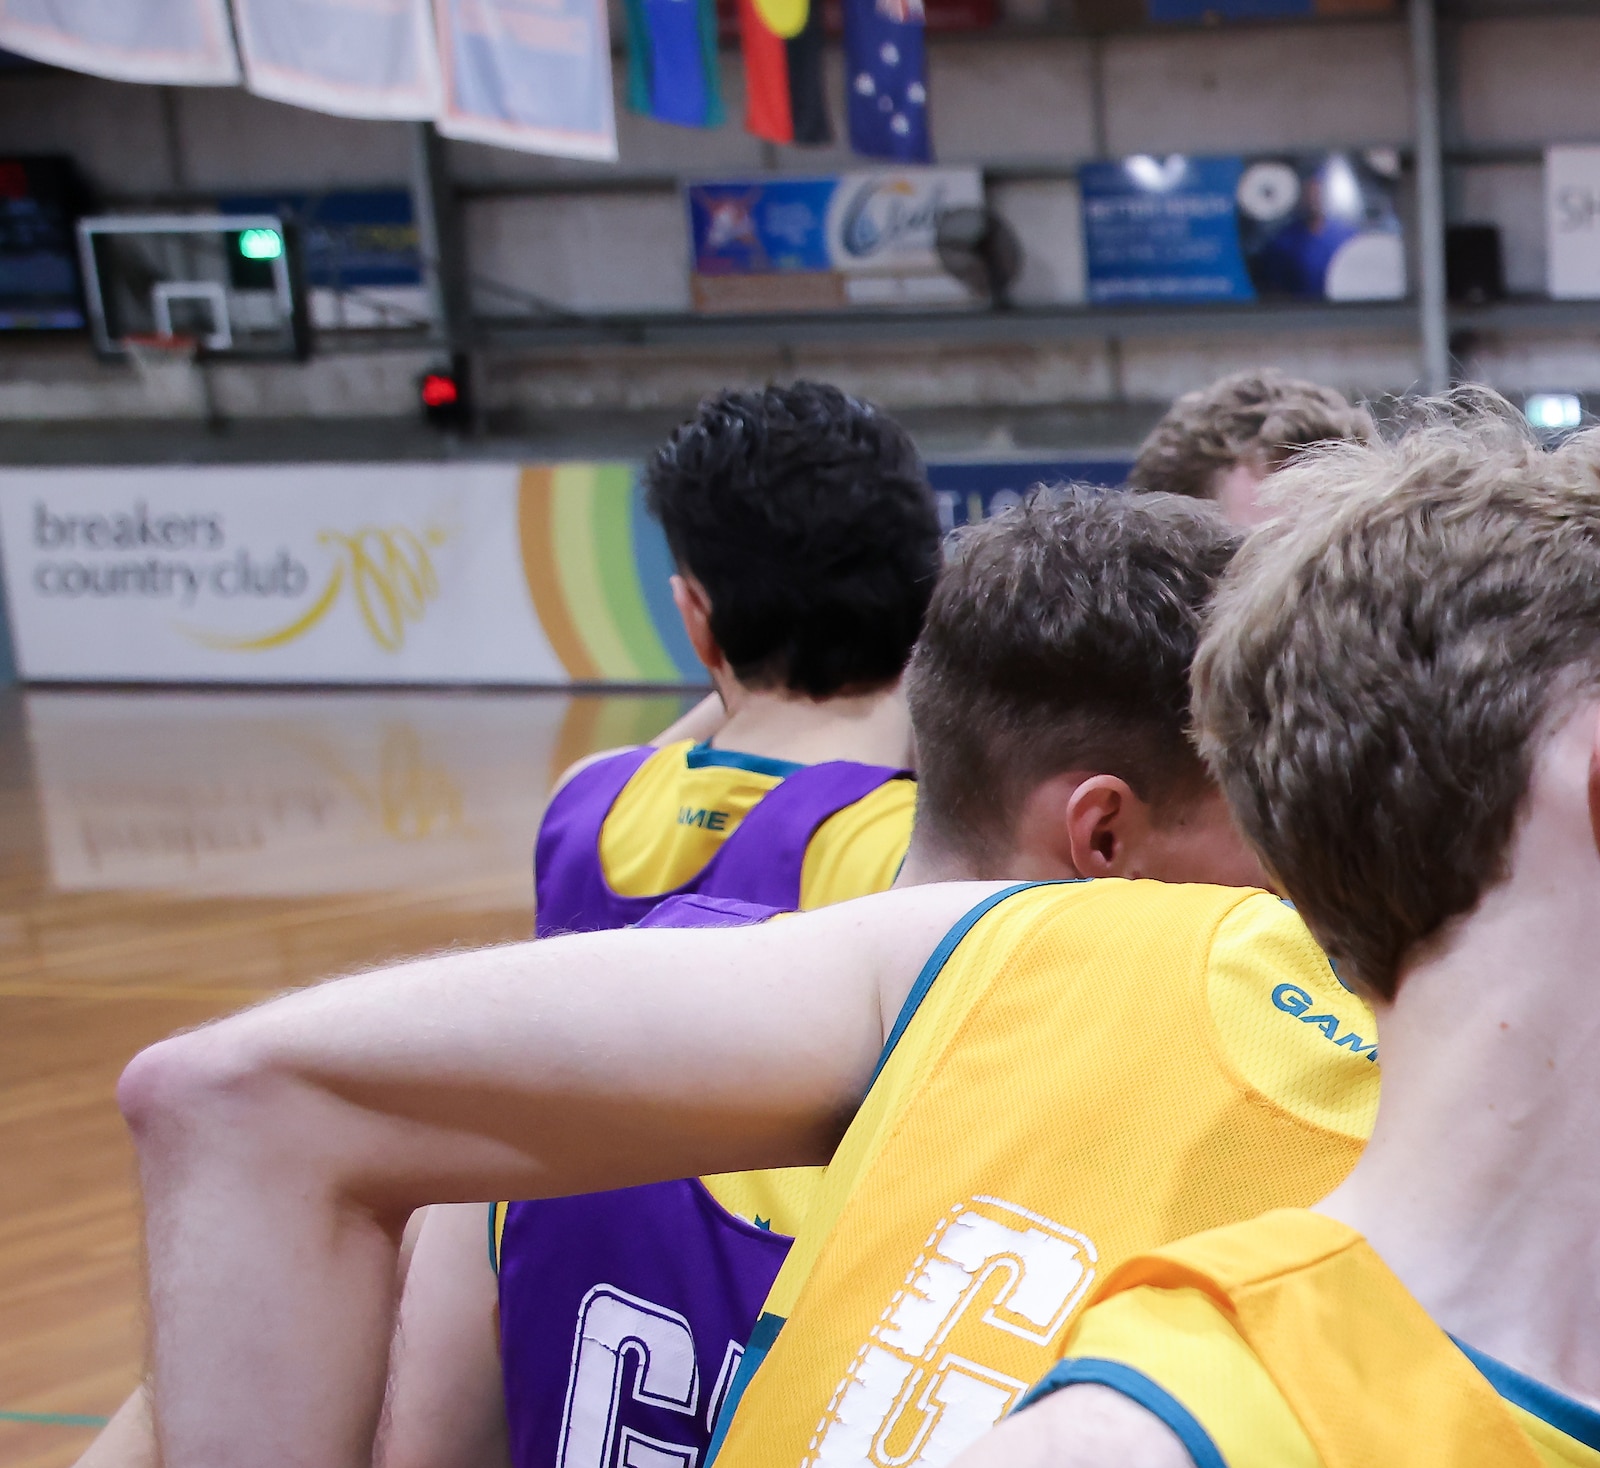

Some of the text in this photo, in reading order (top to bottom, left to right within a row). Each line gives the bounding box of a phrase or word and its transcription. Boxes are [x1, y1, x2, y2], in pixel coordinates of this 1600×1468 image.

[33, 499, 224, 551] breakers
[33, 547, 308, 607] country club
